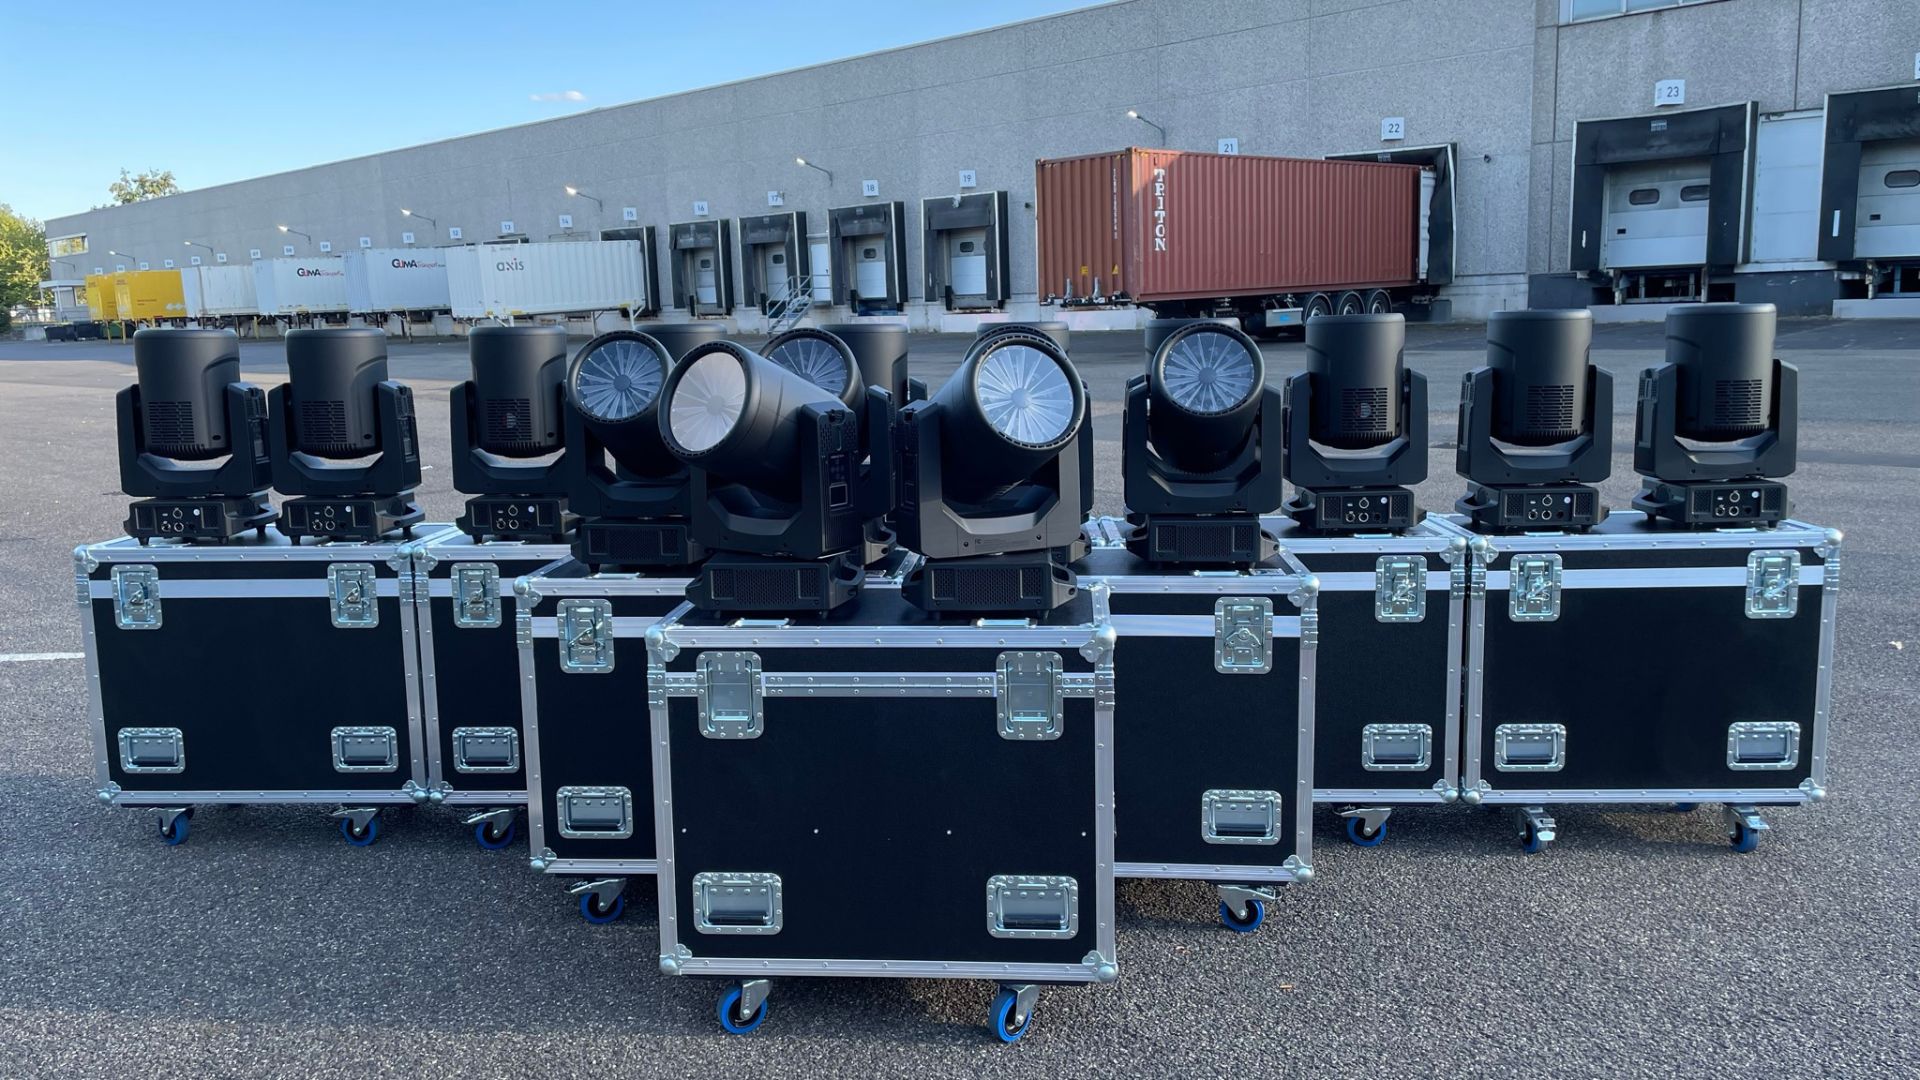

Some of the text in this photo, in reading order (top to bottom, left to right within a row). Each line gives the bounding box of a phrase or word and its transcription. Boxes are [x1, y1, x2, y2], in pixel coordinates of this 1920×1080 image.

[1666, 86, 1679, 98] 23
[1387, 123, 1400, 134] 22
[1223, 143, 1233, 153] 21
[963, 174, 972, 183] 19
[866, 183, 875, 192] 18
[697, 204, 705, 212] 16
[1153, 168, 1166, 251] TRITON
[626, 209, 634, 218] 15
[561, 217, 569, 225] 14
[496, 257, 525, 272] axis
